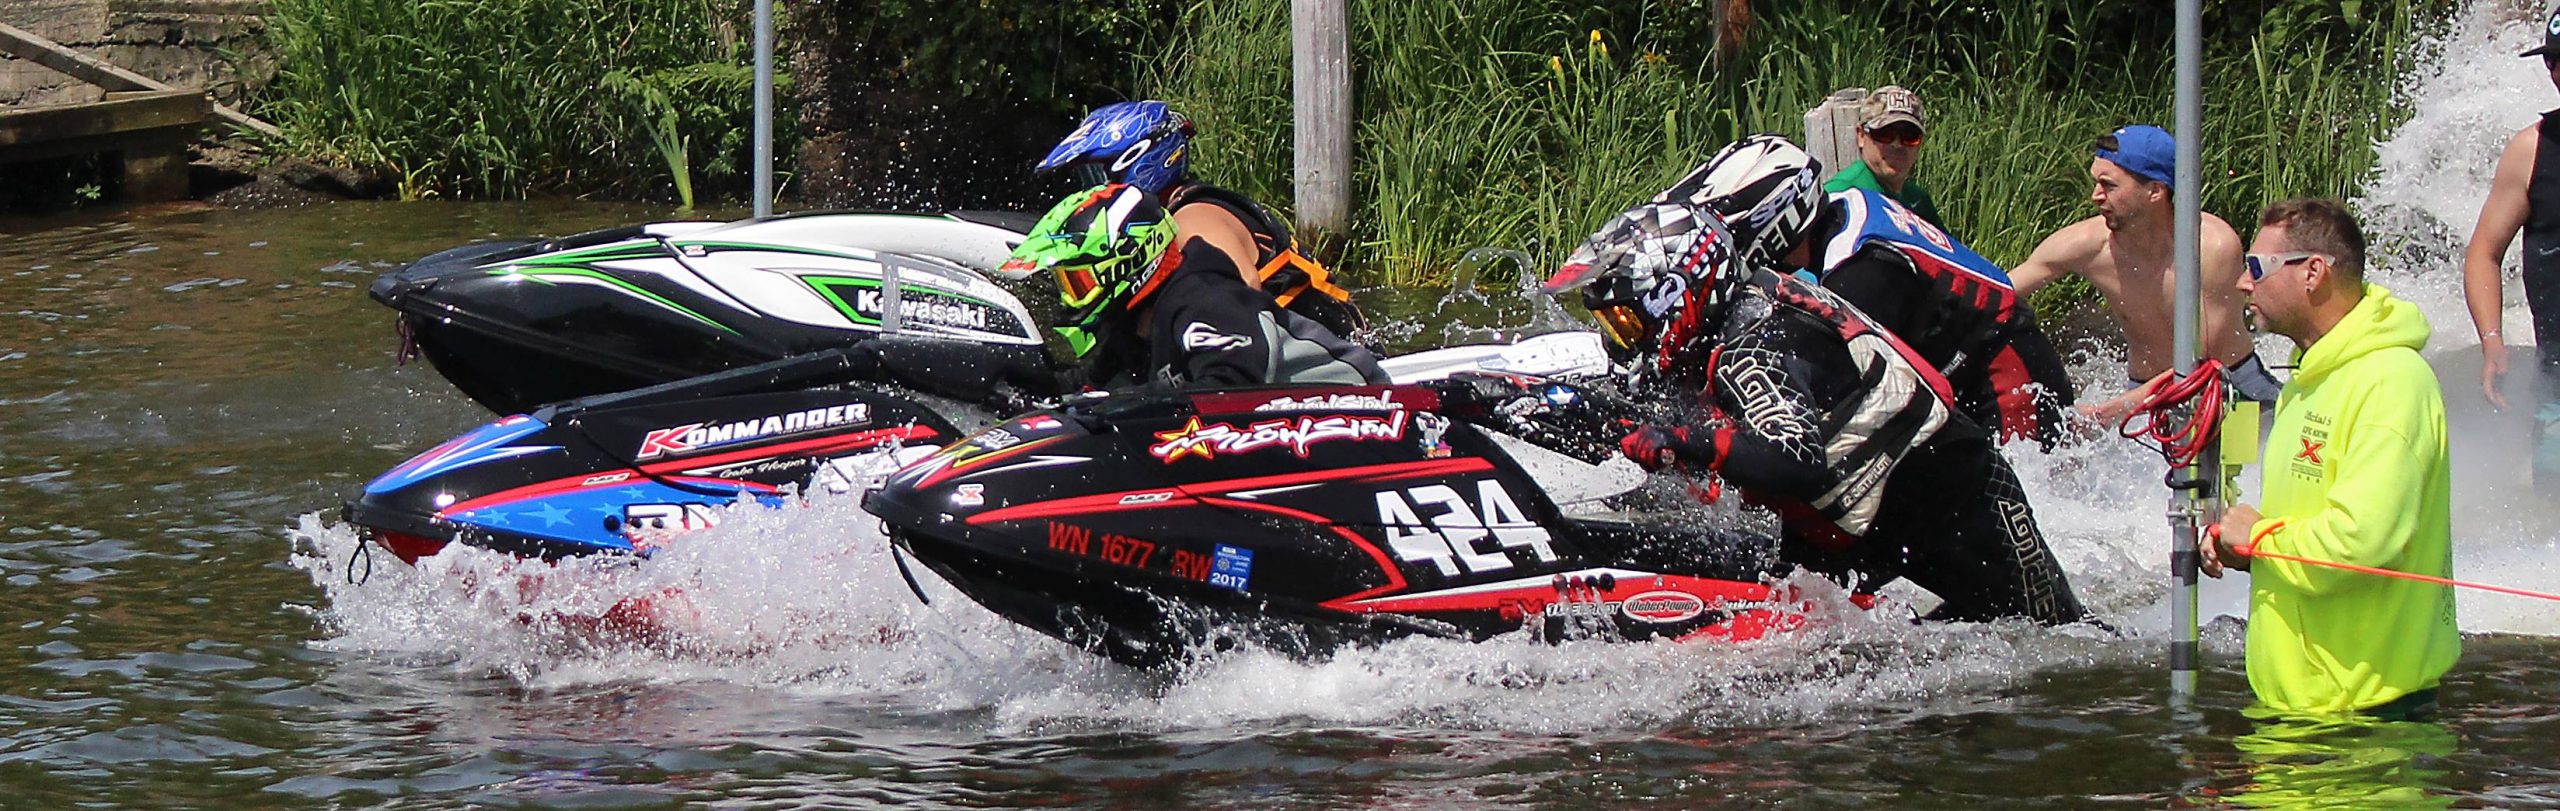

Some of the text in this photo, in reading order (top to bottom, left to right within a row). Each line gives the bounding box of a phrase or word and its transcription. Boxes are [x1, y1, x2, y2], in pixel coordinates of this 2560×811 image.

[857, 289, 987, 329] Kwasaki
[1049, 520, 1213, 580] WN 1677 RW
[1376, 479, 1557, 577] 424
[1211, 572, 1247, 589] 2017
